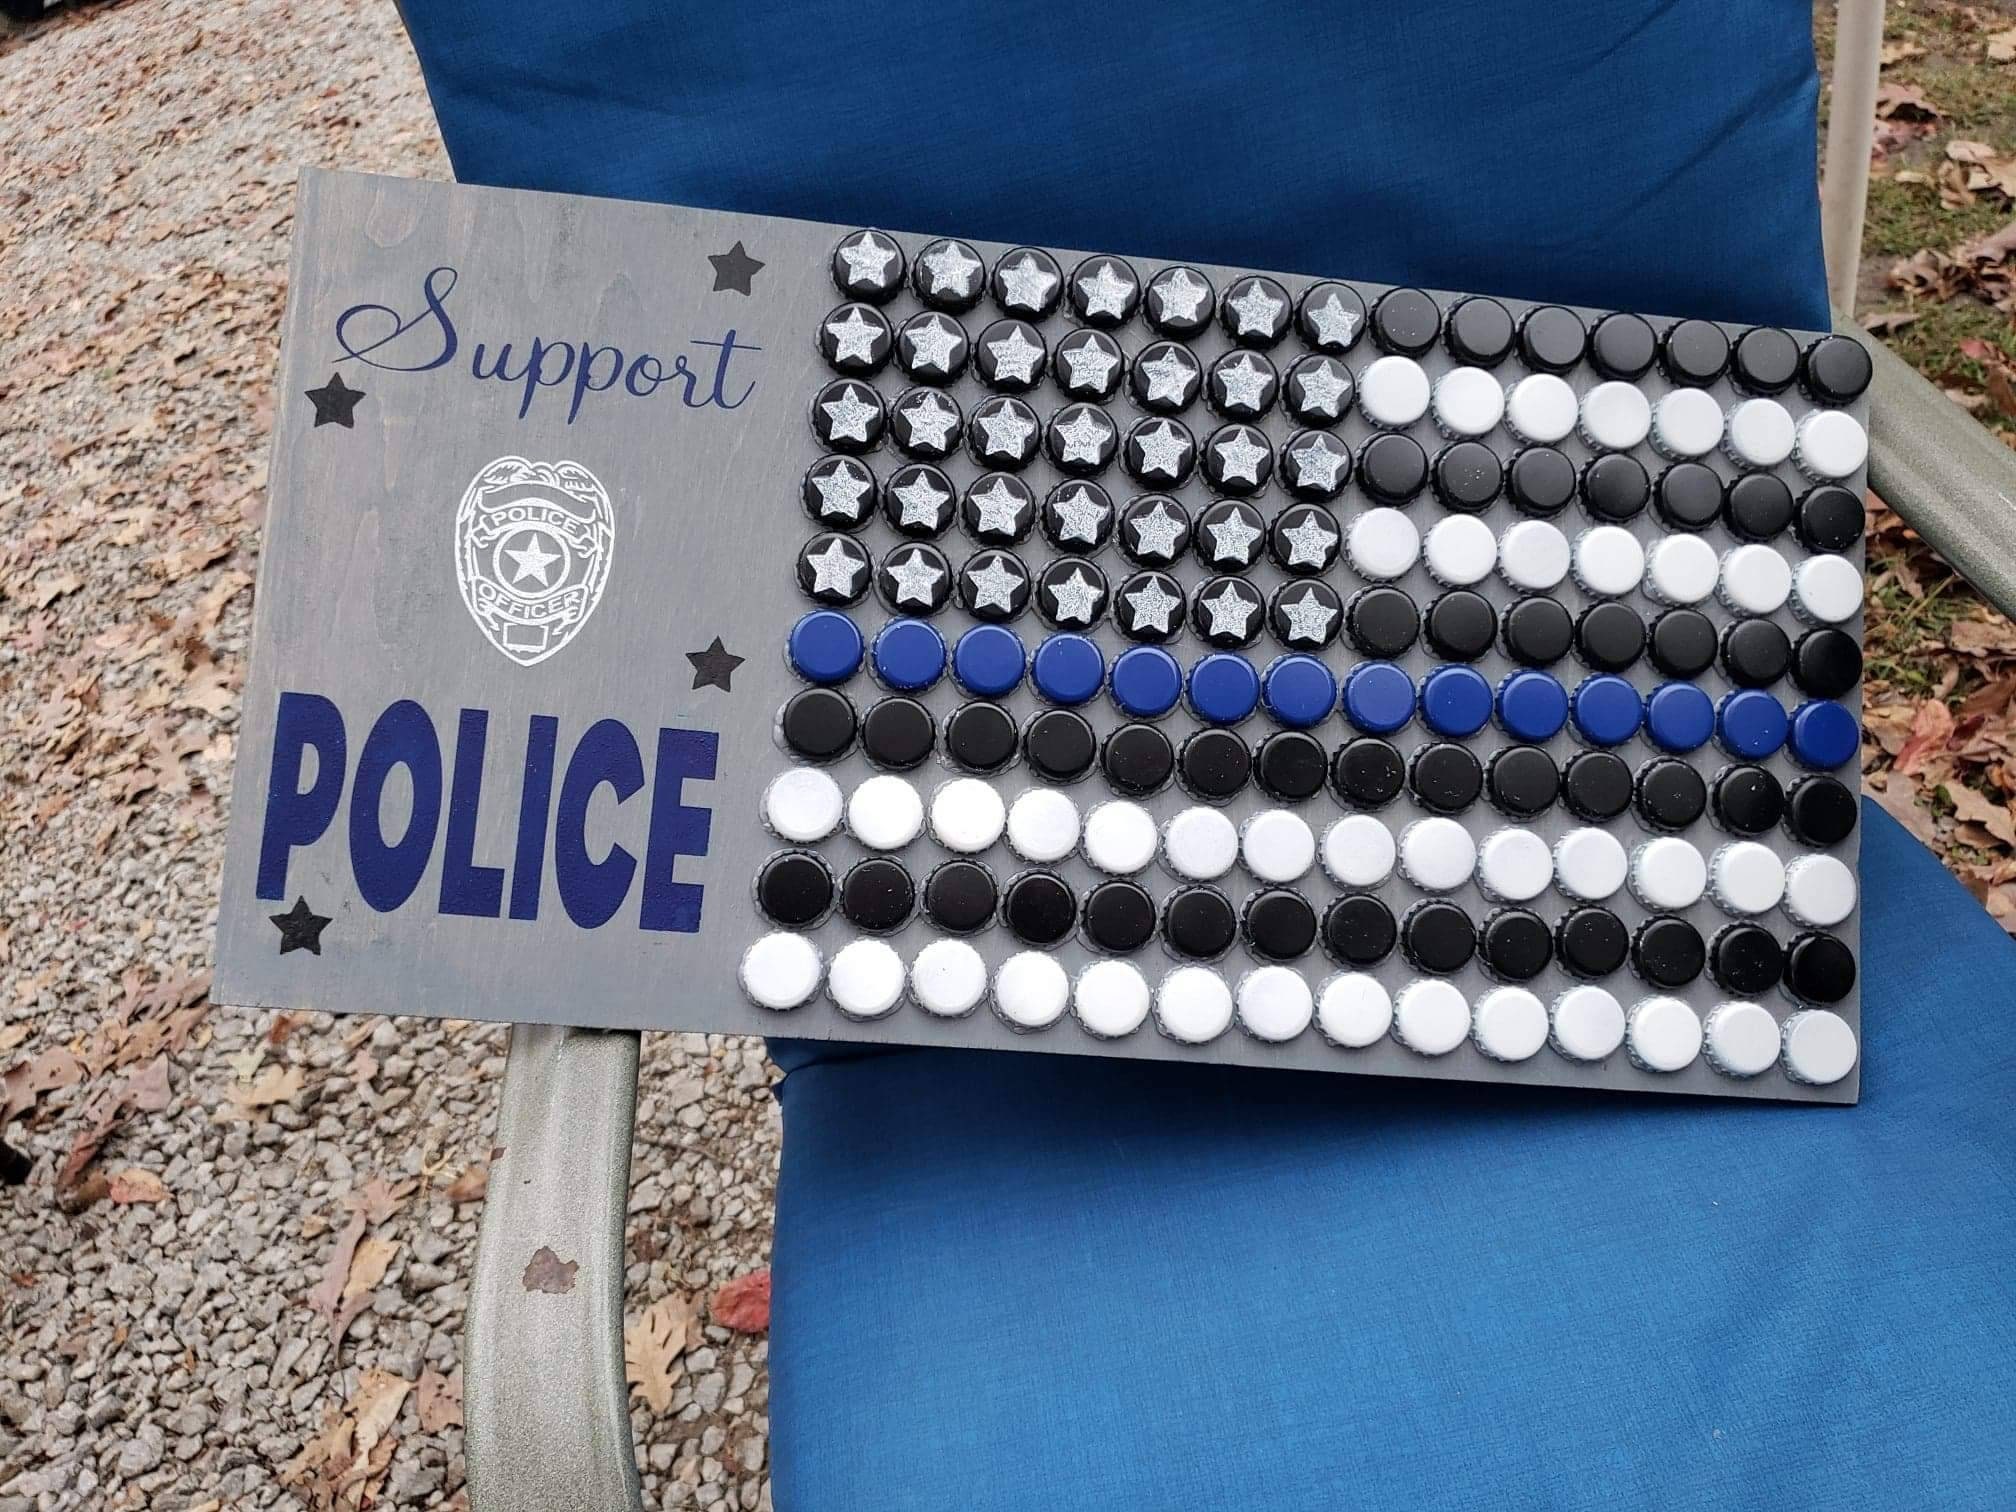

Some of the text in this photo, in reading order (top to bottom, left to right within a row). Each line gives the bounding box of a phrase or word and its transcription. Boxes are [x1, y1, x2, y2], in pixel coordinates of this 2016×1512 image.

[331, 266, 762, 424] Support
[492, 506, 582, 535] POLICE
[478, 583, 582, 619] OFFICER
[255, 691, 720, 934] POLICE
